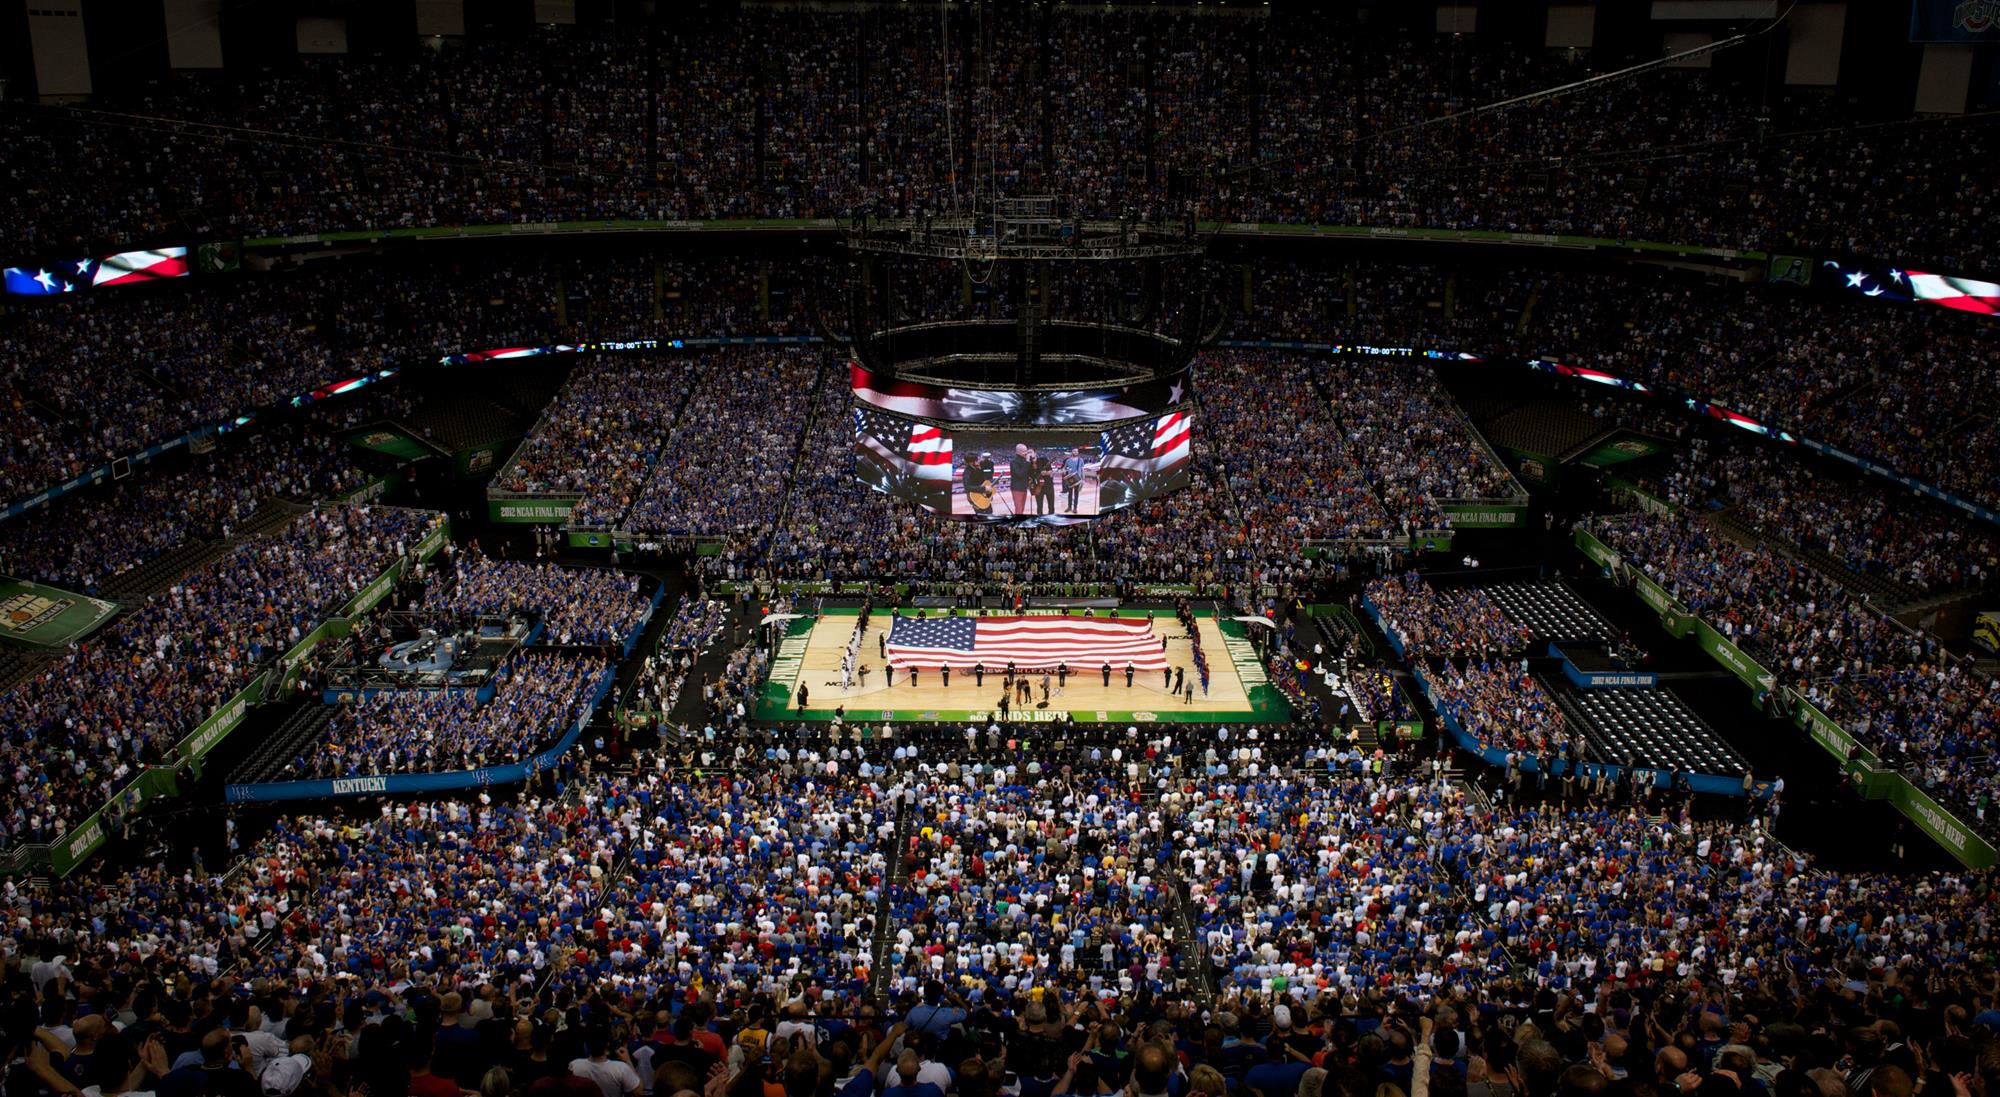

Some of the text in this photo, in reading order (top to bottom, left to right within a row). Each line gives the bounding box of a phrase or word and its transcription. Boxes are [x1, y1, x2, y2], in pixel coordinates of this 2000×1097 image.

[501, 507, 515, 517] 2012
[517, 507, 534, 517] NCAA
[535, 507, 554, 517] FINAL
[1461, 512, 1478, 523] NCAA
[1479, 512, 1497, 523] FINAL
[1498, 512, 1516, 523] FOUR
[966, 609, 994, 617] NCA
[1592, 676, 1653, 685] 2012 NCAA FINAL FOUR
[333, 777, 387, 795] KENTUCKY
[1927, 808, 1946, 834] ENDS
[1945, 823, 1967, 850] HERE
[70, 833, 88, 859] 2012
